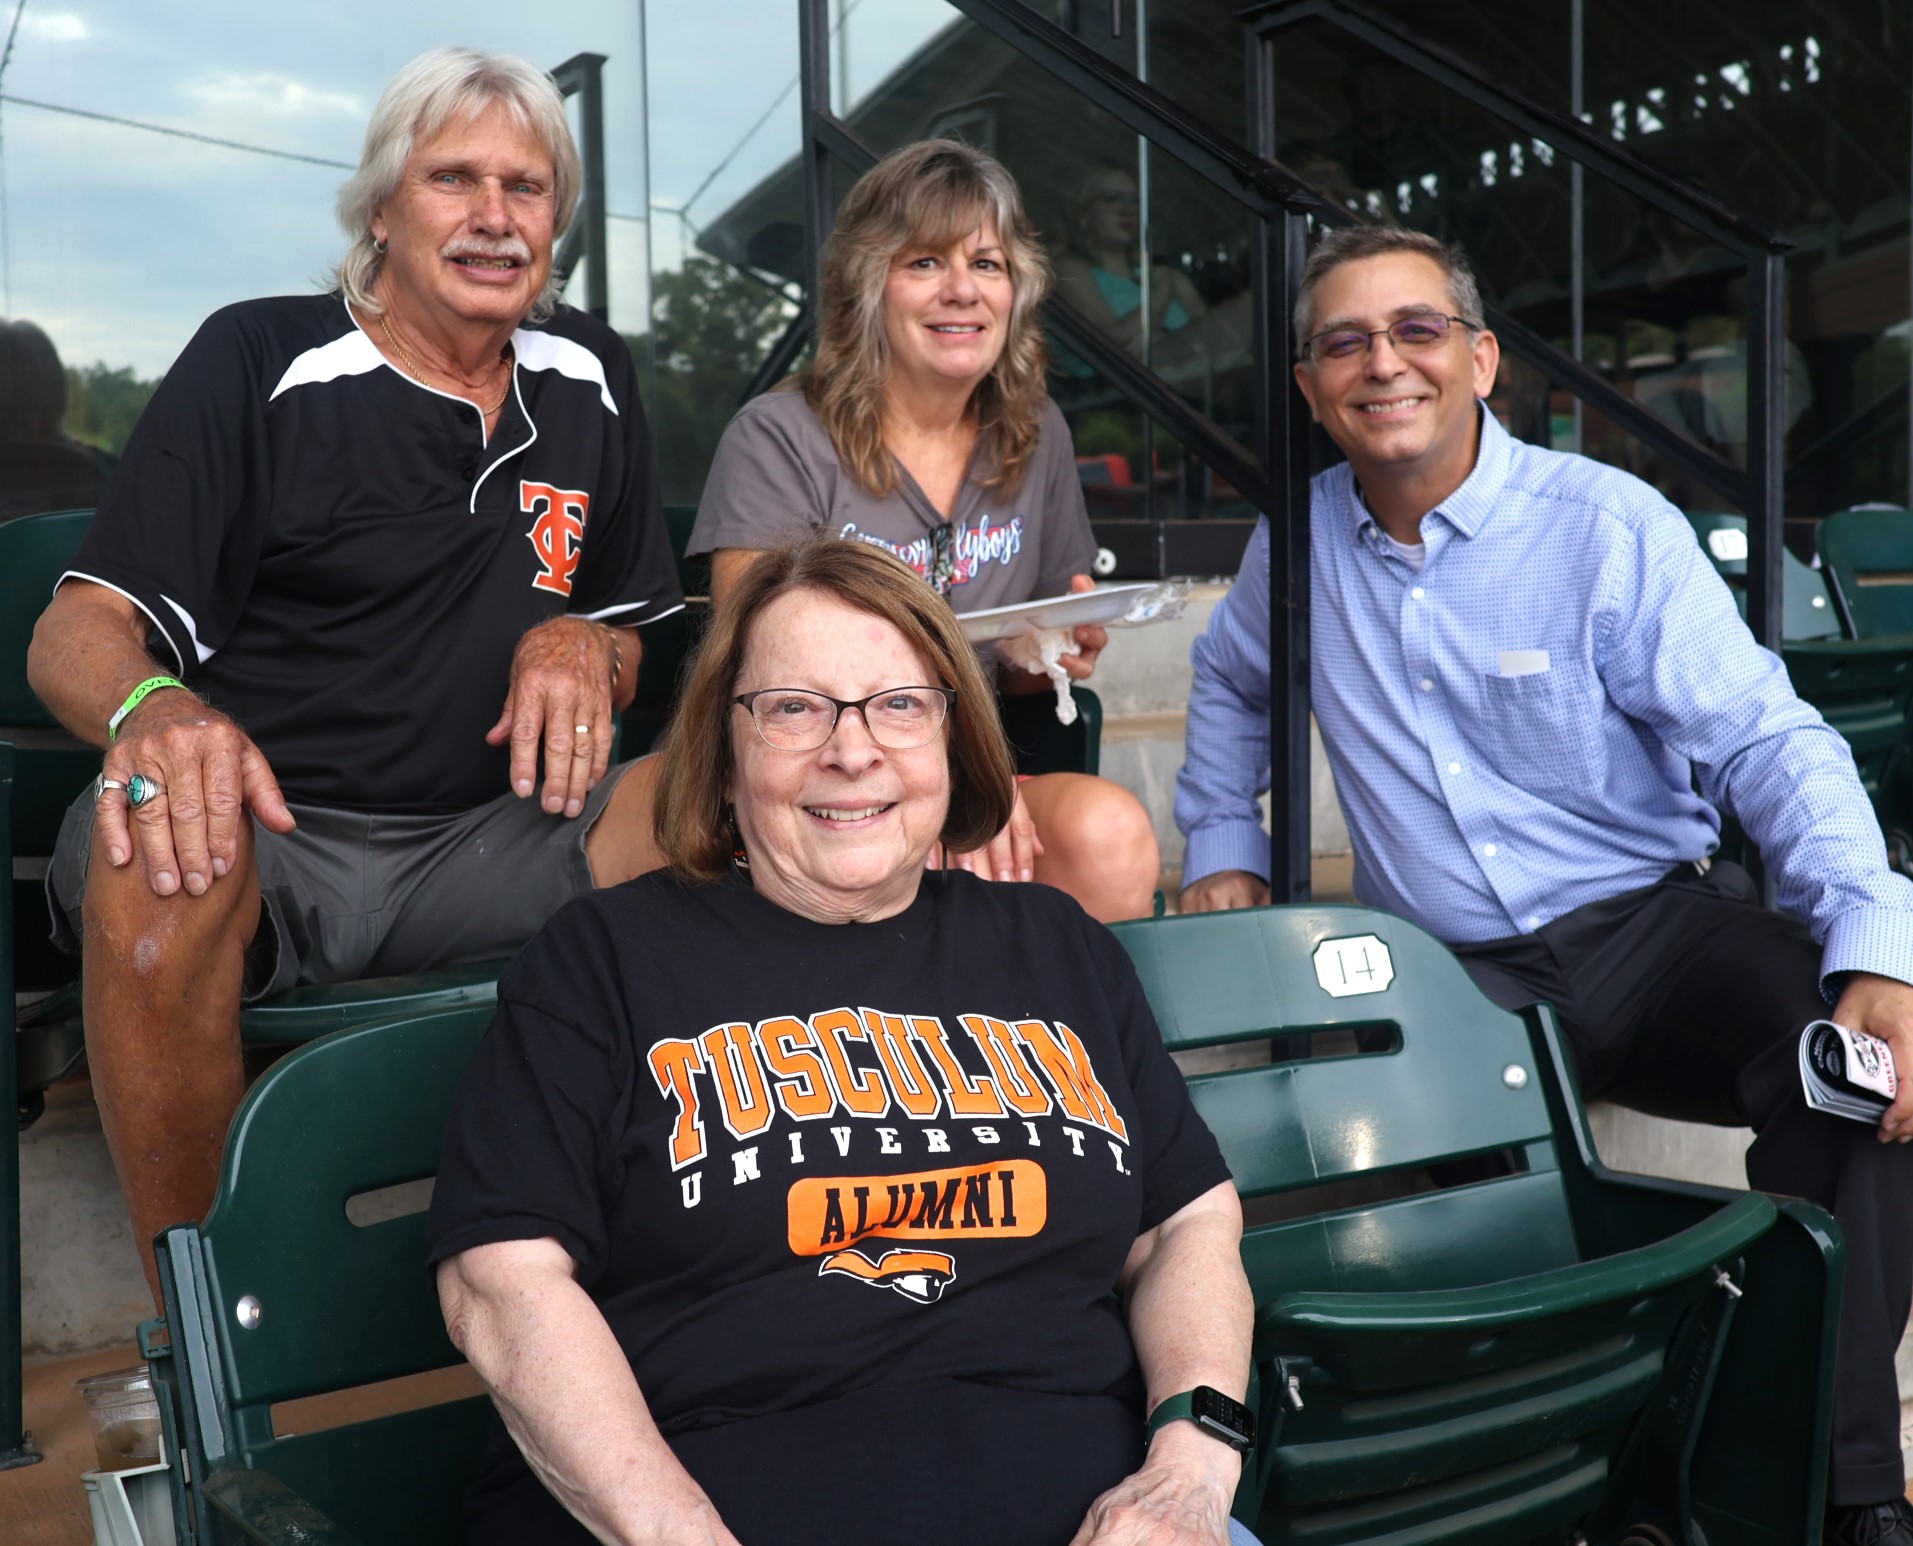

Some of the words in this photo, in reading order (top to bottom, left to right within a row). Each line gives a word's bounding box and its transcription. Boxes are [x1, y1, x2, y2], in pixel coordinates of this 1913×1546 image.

[955, 514, 1023, 578] lyboys
[1336, 946, 1376, 985] 14
[647, 1007, 1130, 1171] TUSCULUM
[681, 1121, 1124, 1209] UNIVERSITY
[820, 1170, 1018, 1246] ALUMNI
